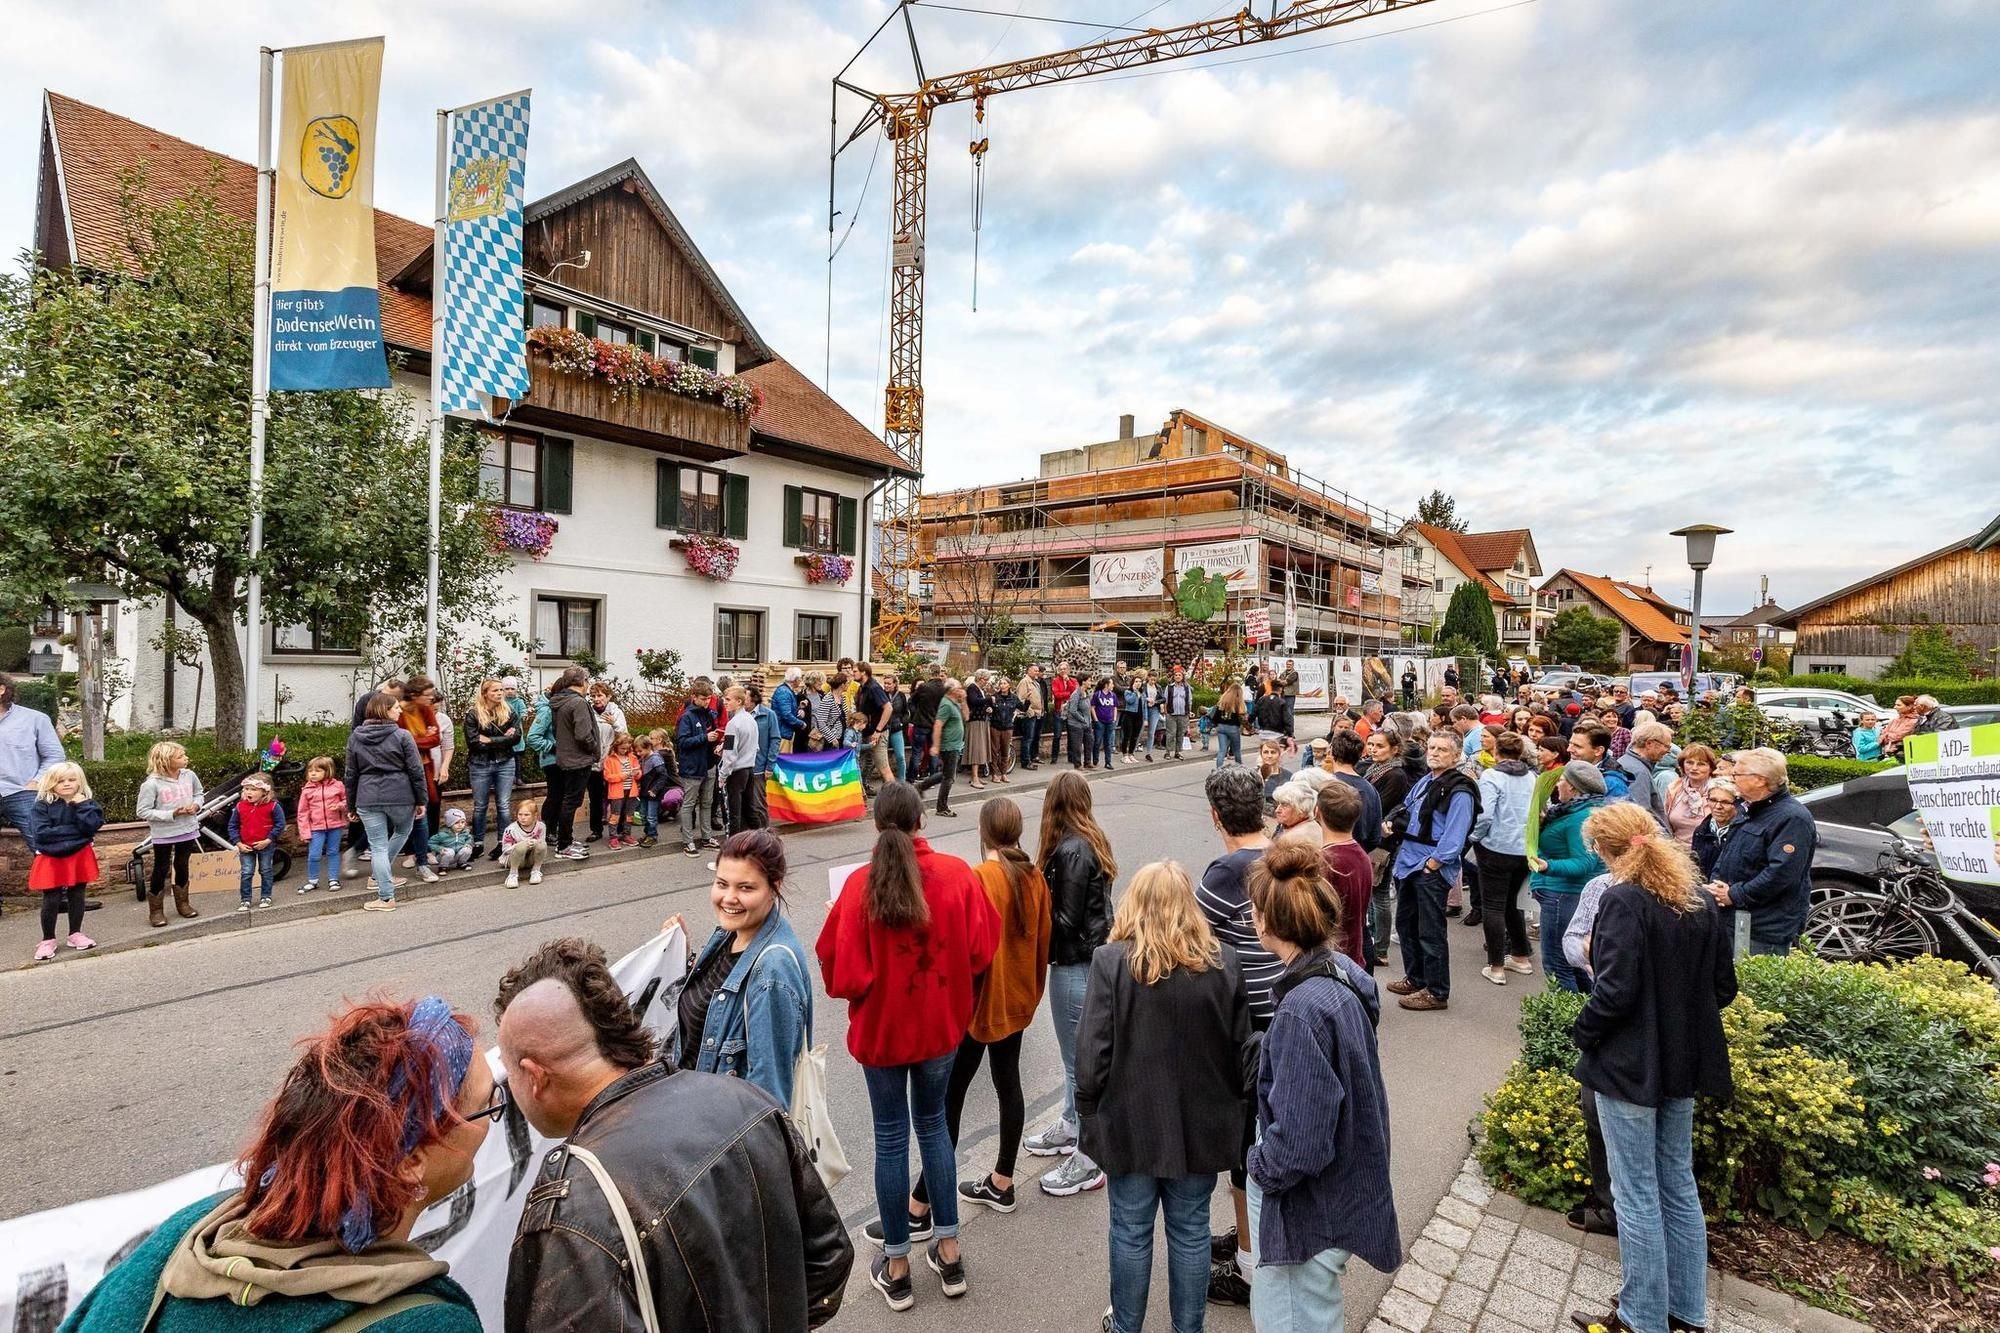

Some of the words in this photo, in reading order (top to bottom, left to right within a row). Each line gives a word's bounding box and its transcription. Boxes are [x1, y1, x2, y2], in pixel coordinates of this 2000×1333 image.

[275, 299, 293, 311] Hier
[276, 314, 376, 333] BodenseeWein
[275, 341, 302, 352] direkt
[307, 343, 328, 352] vom
[330, 338, 378, 353] Erzeuger
[1939, 765, 1950, 777] für
[1950, 817, 1988, 839] rechte
